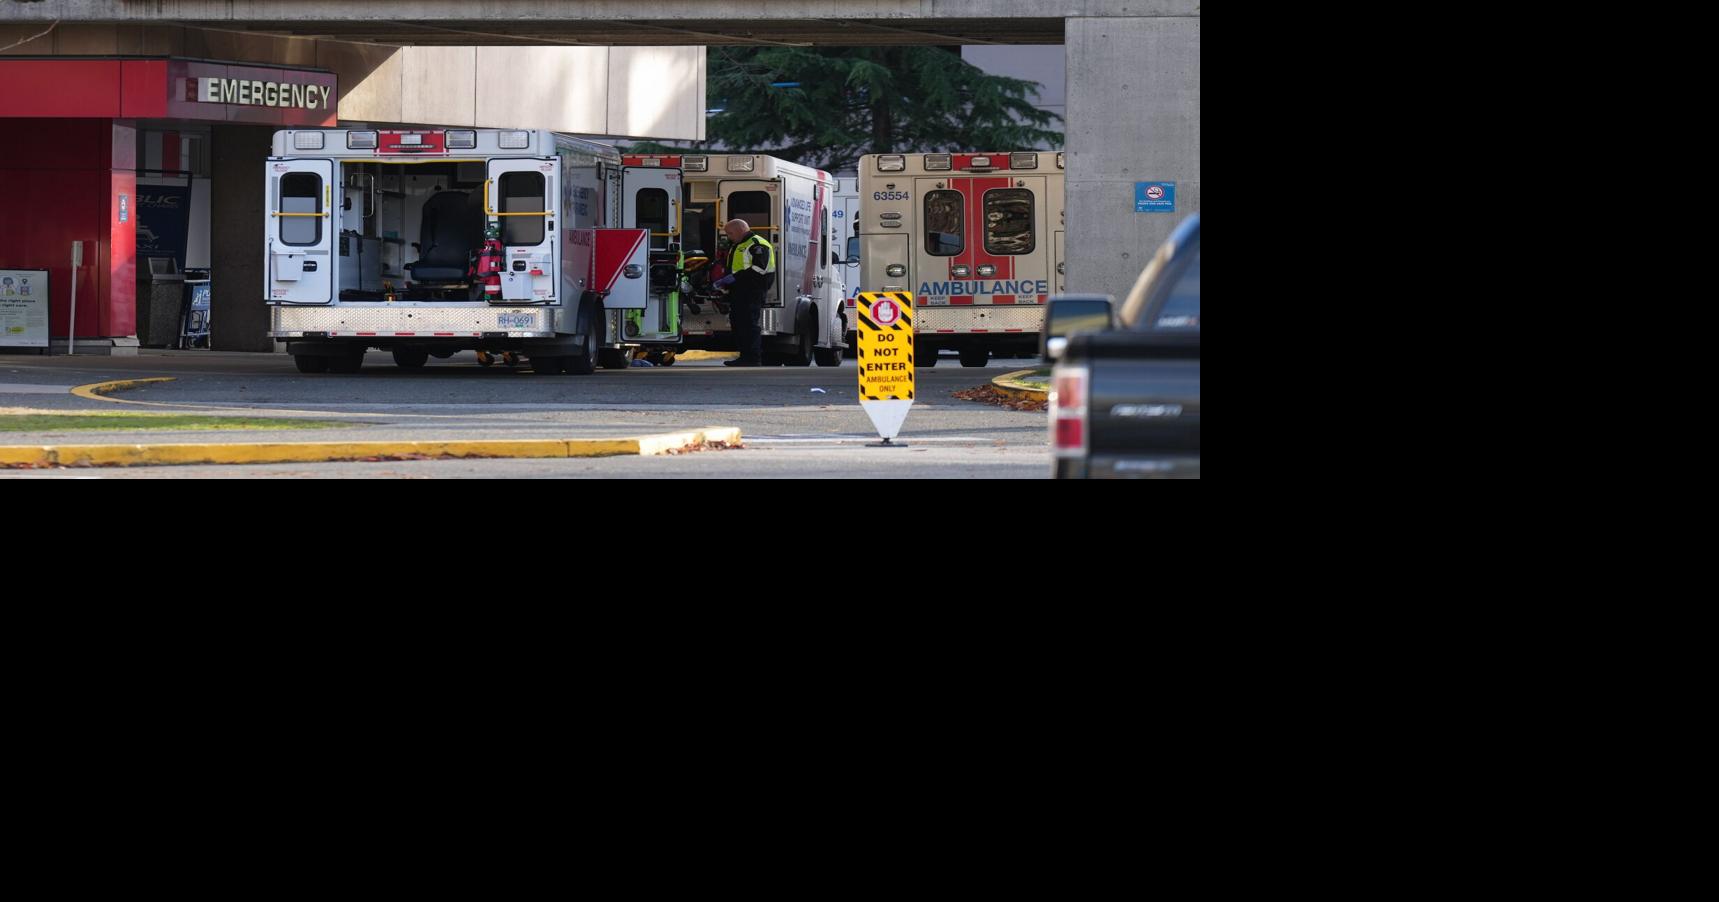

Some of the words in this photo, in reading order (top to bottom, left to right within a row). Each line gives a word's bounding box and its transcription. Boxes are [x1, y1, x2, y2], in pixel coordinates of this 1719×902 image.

[207, 77, 330, 109] EMERGENCY
[873, 191, 909, 200] 63554
[568, 230, 590, 247] AMBULANCE
[787, 242, 807, 257] AMBULANCE
[918, 280, 1047, 295] AMBULANCE
[878, 334, 894, 342] DO
[874, 348, 898, 356] NOT
[866, 363, 906, 371] ENTER
[866, 375, 907, 383] AMBULANCE
